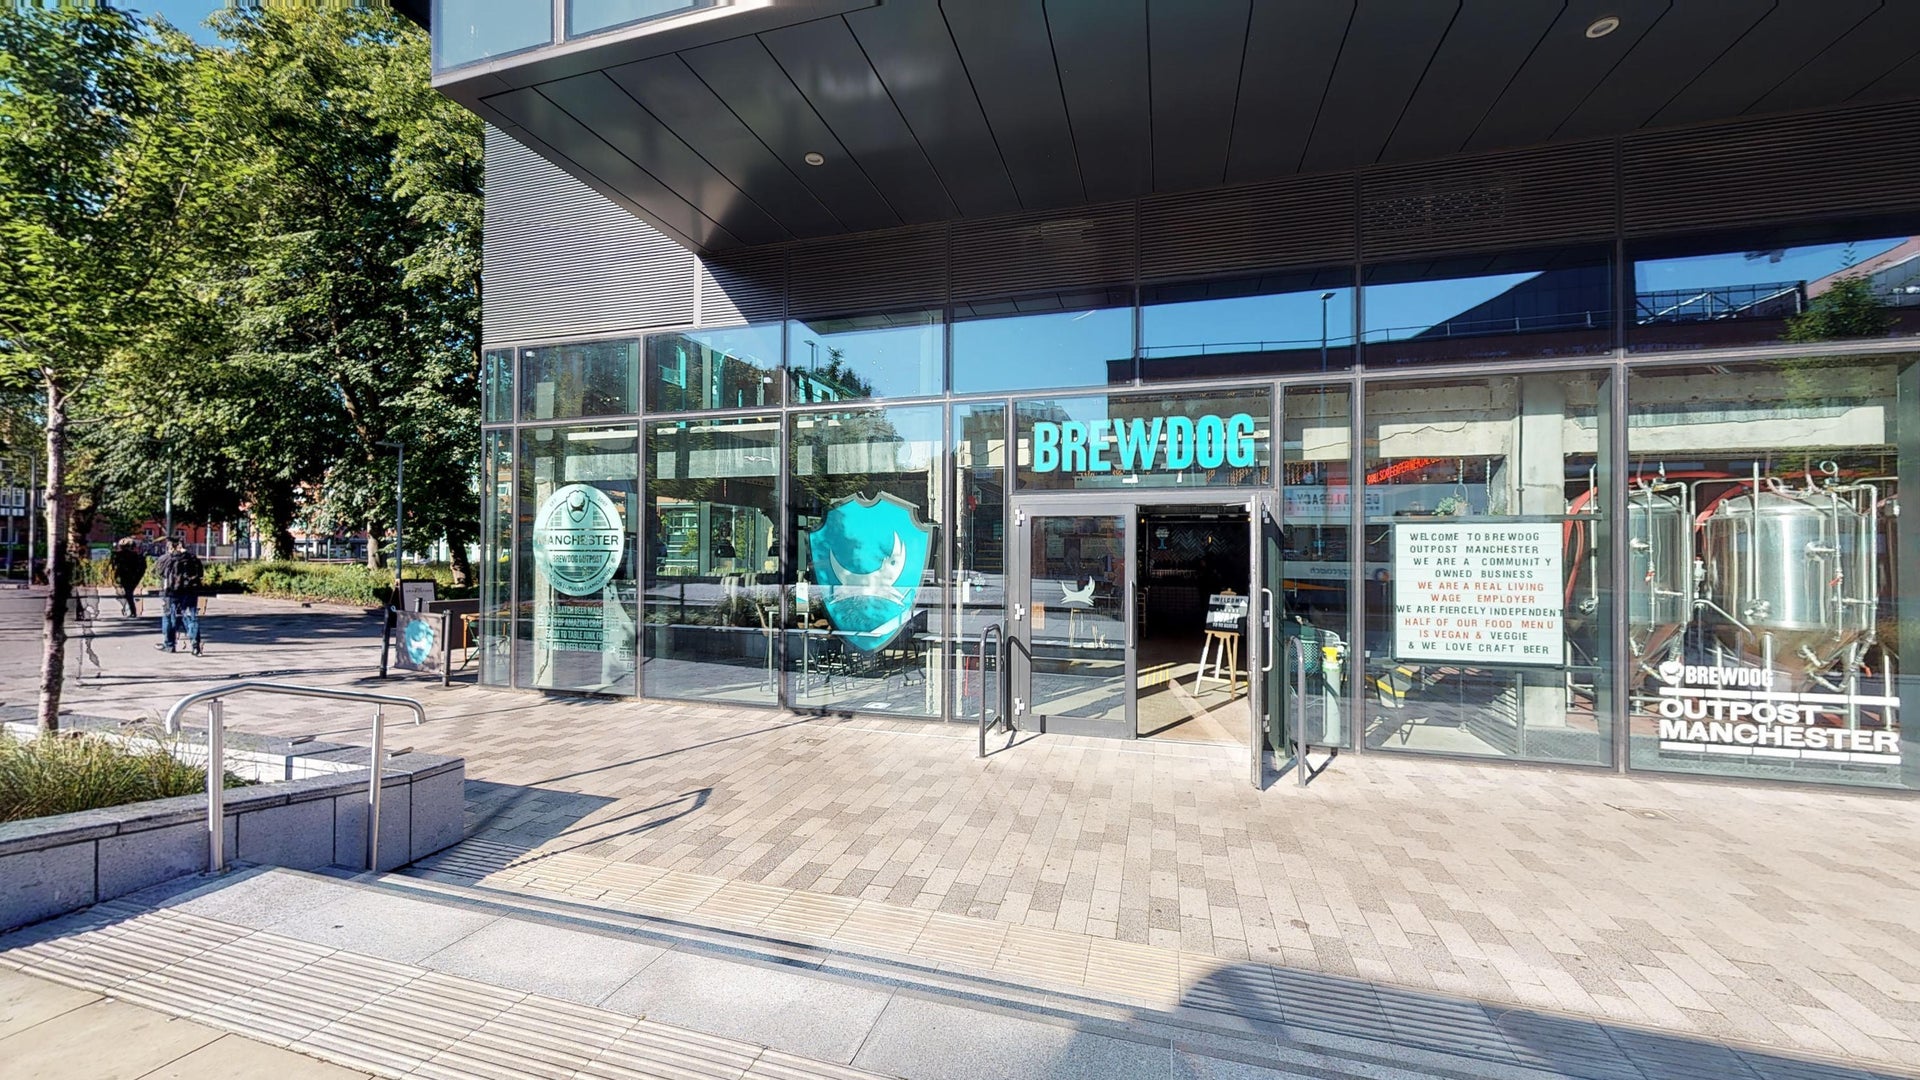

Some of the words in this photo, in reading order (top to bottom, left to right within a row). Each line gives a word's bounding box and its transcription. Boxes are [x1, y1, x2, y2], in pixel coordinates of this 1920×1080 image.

[1033, 413, 1255, 474] BREWDOG
[1410, 532, 1459, 541] WELCOME
[1410, 545, 1457, 553] OUTPOST
[1466, 546, 1539, 554] MANCHESTER
[1414, 558, 1429, 566] WE
[1437, 558, 1456, 566] ARE
[1464, 558, 1469, 566] A
[1436, 570, 1472, 578] OWNED
[1481, 570, 1533, 578] BUSINESS
[1418, 582, 1432, 590] WE
[1439, 582, 1458, 590] ARE
[1464, 582, 1469, 590] A
[1475, 582, 1502, 590] REAL
[1508, 582, 1544, 591] LIVING
[1431, 594, 1461, 602] WAGE
[1478, 595, 1535, 603] EMPLOYER
[1396, 605, 1411, 613] WE
[1417, 605, 1436, 613] ARE
[1440, 606, 1486, 614] FIERCELY
[1490, 608, 1564, 617] INDEPENDENT
[1405, 618, 1431, 626] HALF
[1457, 619, 1478, 627] OUR
[1486, 620, 1512, 628] FOOD
[1420, 630, 1429, 638] IS
[1435, 631, 1469, 639] VEGAN
[1491, 632, 1528, 640] VEGGIE
[1446, 643, 1472, 651] LOVE
[1479, 644, 1514, 652] CRAFT
[1524, 645, 1549, 653] BEER
[1685, 665, 1774, 687] BREWDOG
[1659, 698, 1823, 725] OUTPOST
[1659, 719, 1900, 753] MANCHESTER
